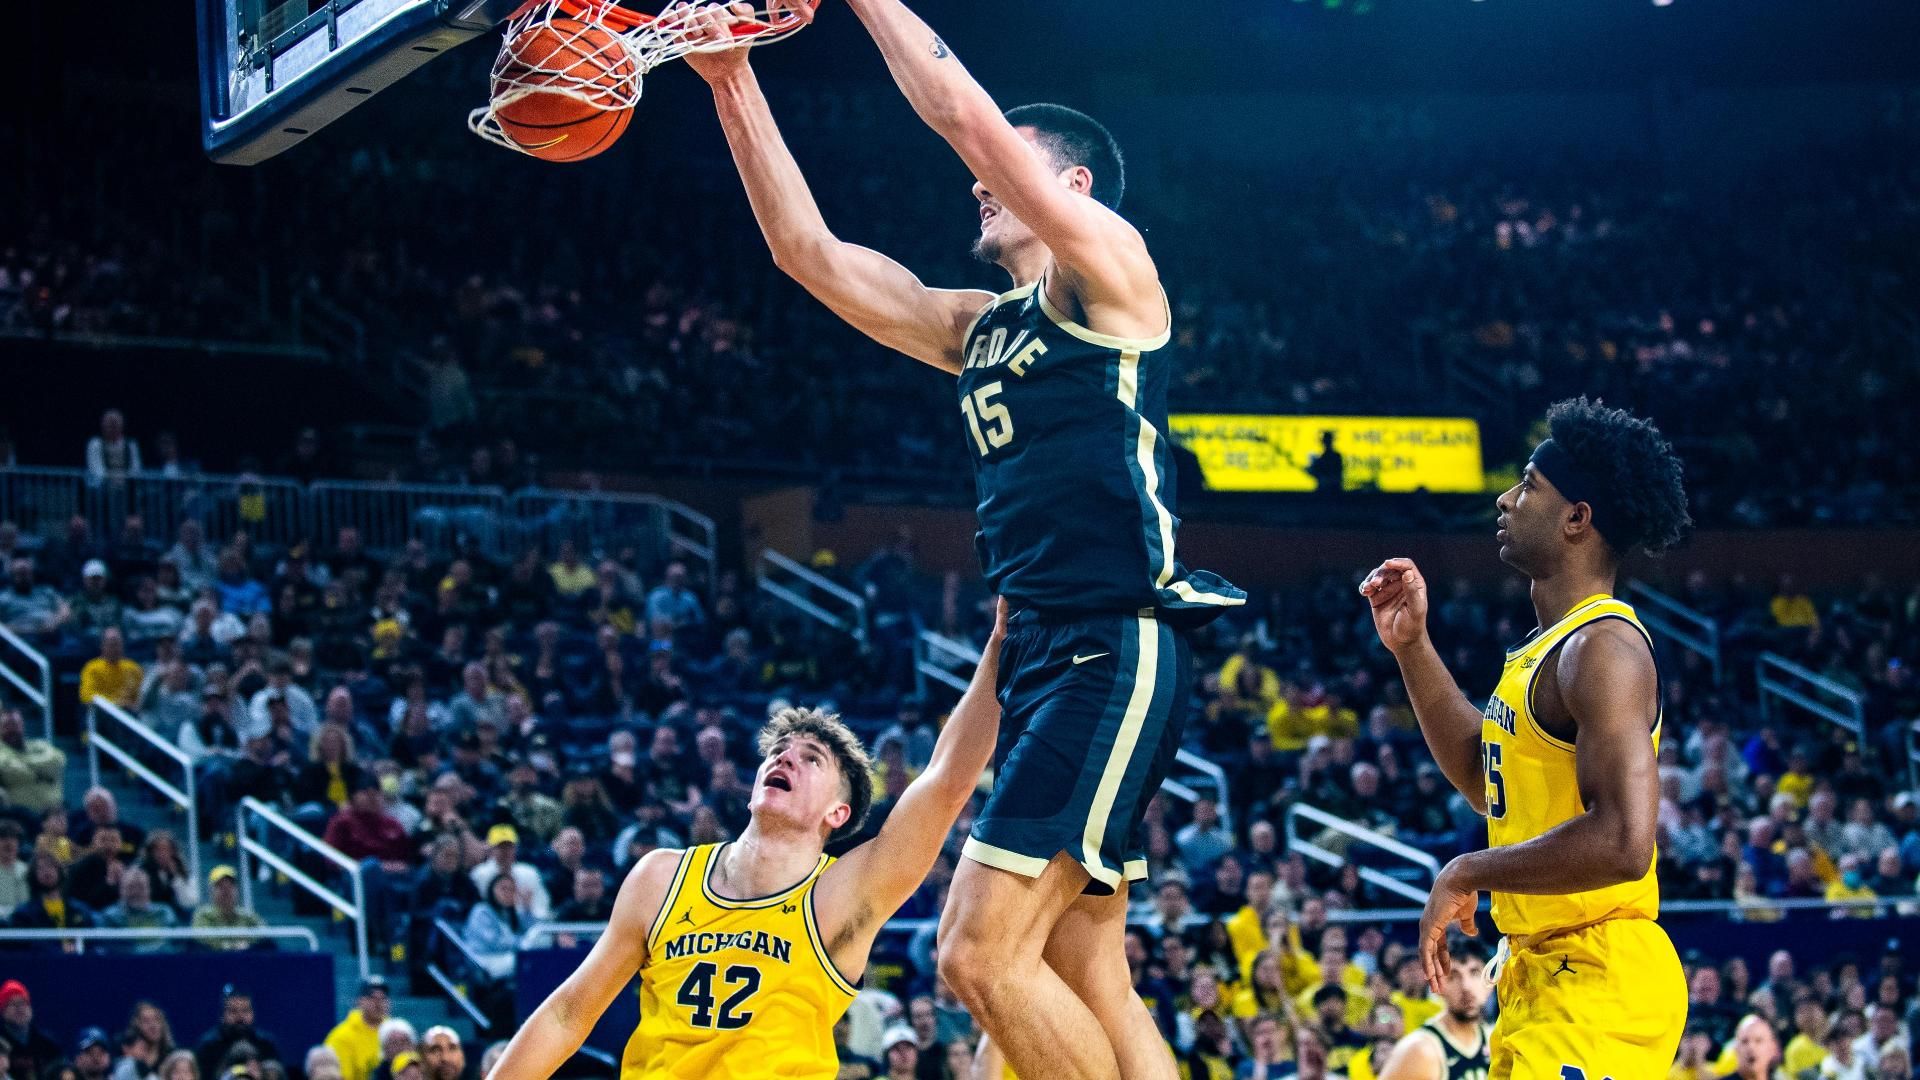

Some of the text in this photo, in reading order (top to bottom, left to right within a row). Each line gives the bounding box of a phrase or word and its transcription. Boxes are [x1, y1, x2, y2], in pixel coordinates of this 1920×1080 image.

[961, 380, 1014, 457] 15
[1482, 741, 1507, 819] 5
[665, 930, 792, 964] MICHIGAN
[676, 960, 762, 1031] 42
